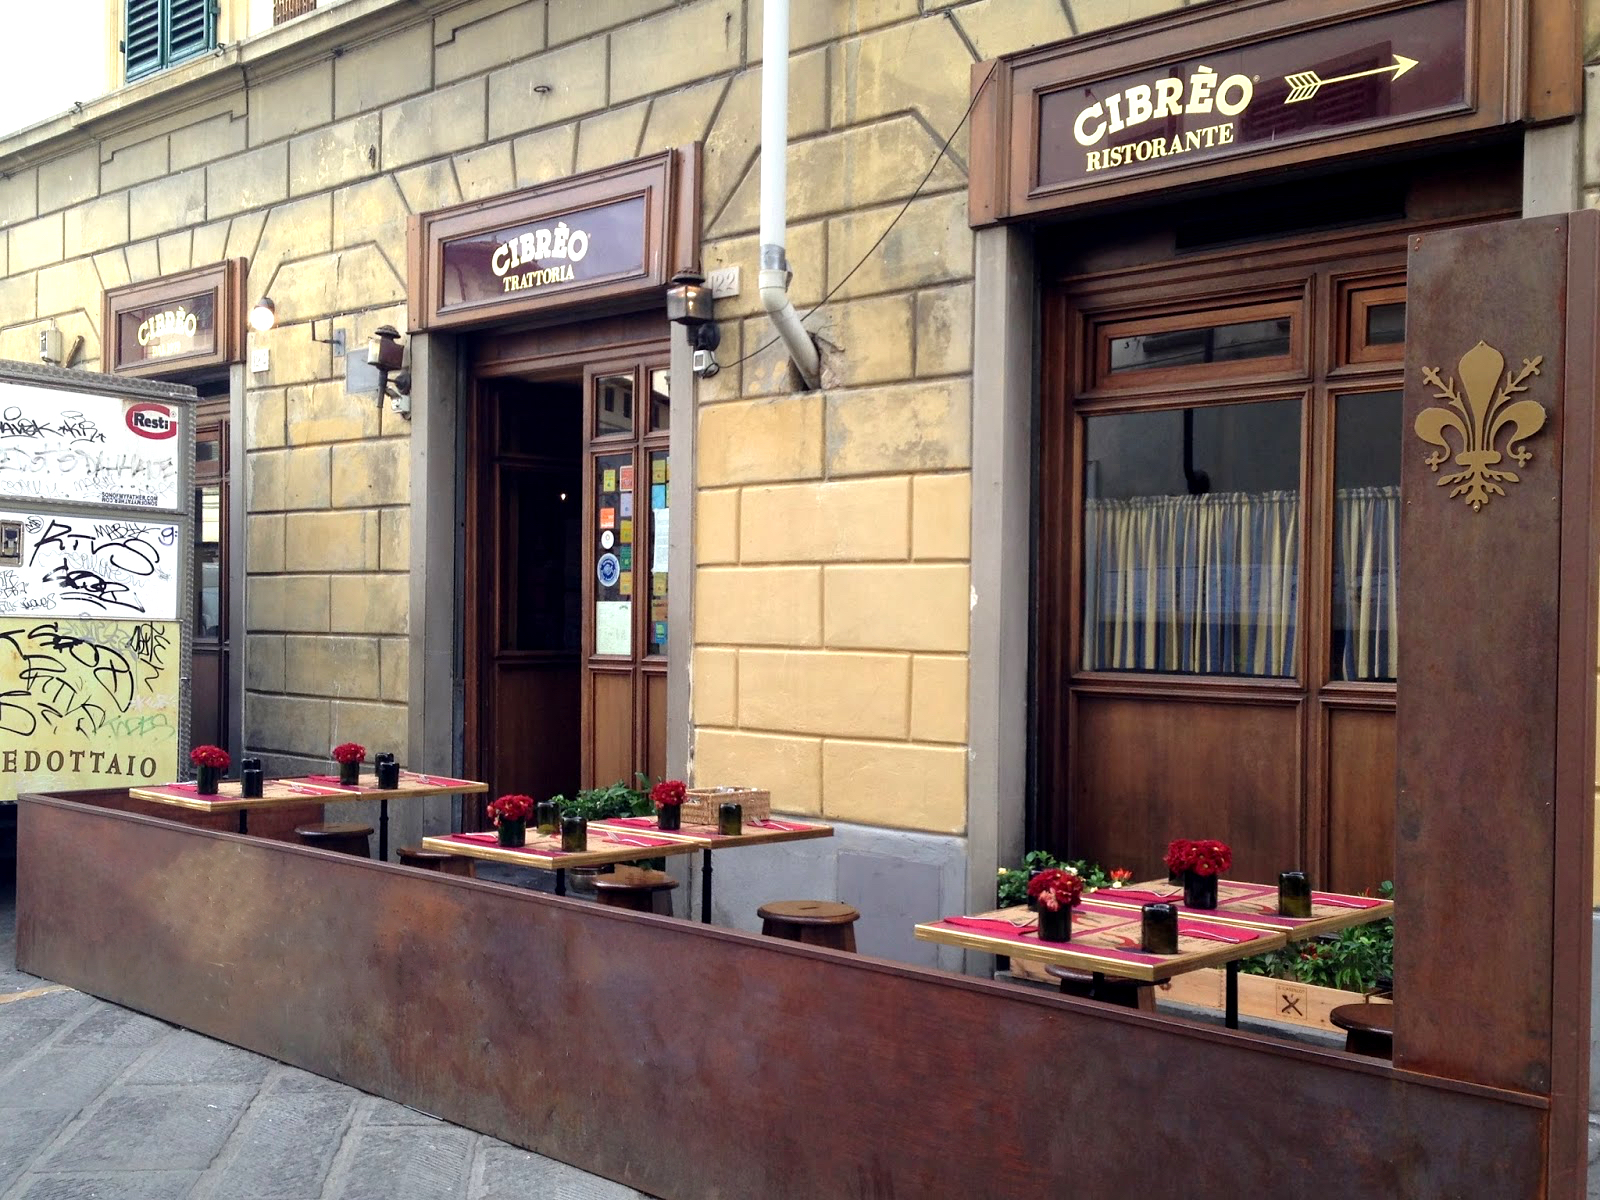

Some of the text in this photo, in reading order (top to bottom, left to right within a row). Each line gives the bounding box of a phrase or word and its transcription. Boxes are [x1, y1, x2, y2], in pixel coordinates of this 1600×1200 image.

[1073, 65, 1254, 146] CIBRÈO
[1085, 122, 1234, 172] RISTORANTE
[502, 264, 575, 293] TRATTORIA
[133, 412, 169, 430] Resti
[2, 749, 157, 779] EDOTTAIO
